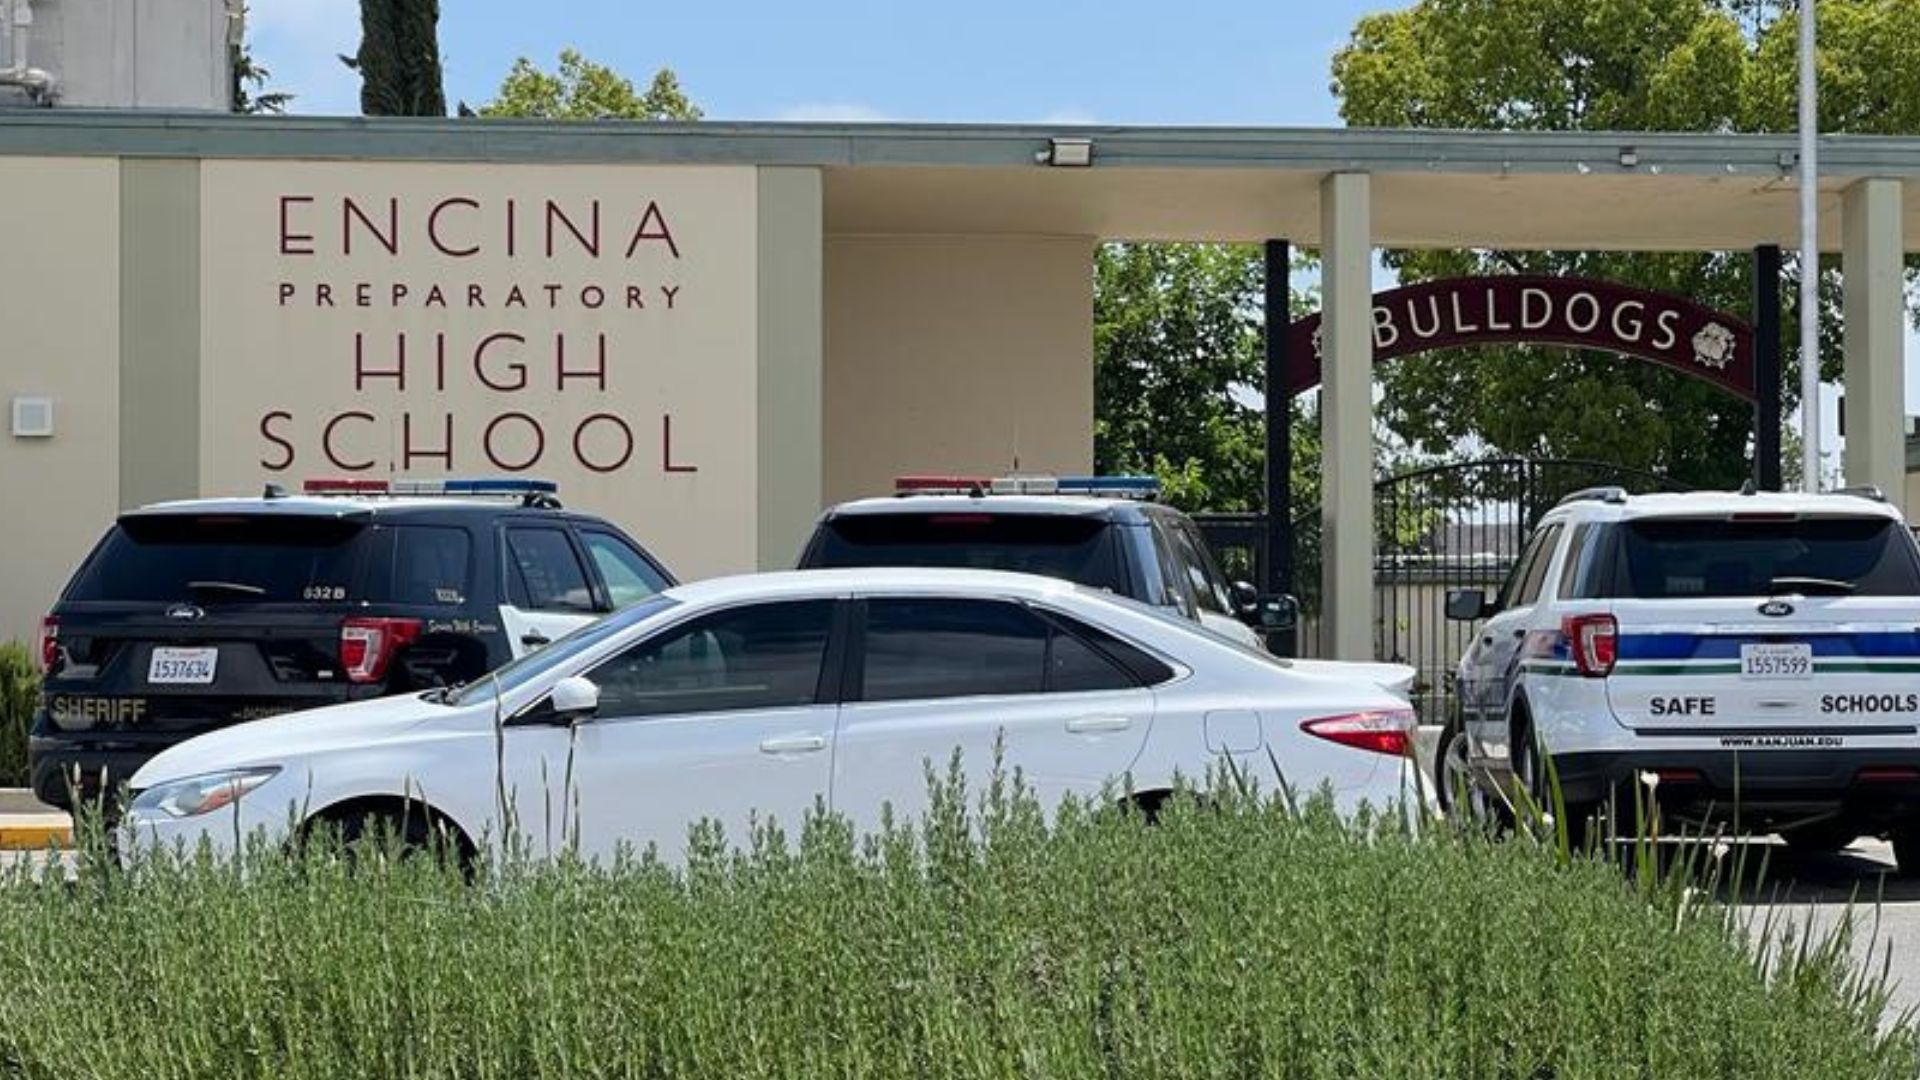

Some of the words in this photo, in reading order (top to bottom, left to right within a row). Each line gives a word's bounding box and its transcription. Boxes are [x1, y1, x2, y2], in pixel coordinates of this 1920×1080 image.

[279, 197, 679, 258] ENCINA
[279, 284, 680, 308] PREPARATORY
[1372, 287, 1680, 350] BULLDOGS
[356, 332, 606, 391] HIGH
[259, 411, 698, 472] SCHOOL
[1747, 657, 1808, 674] 1557599
[53, 697, 146, 722] SHERIFF
[1650, 697, 1716, 715] SAFE
[1821, 694, 1919, 713] SCHOOLS
